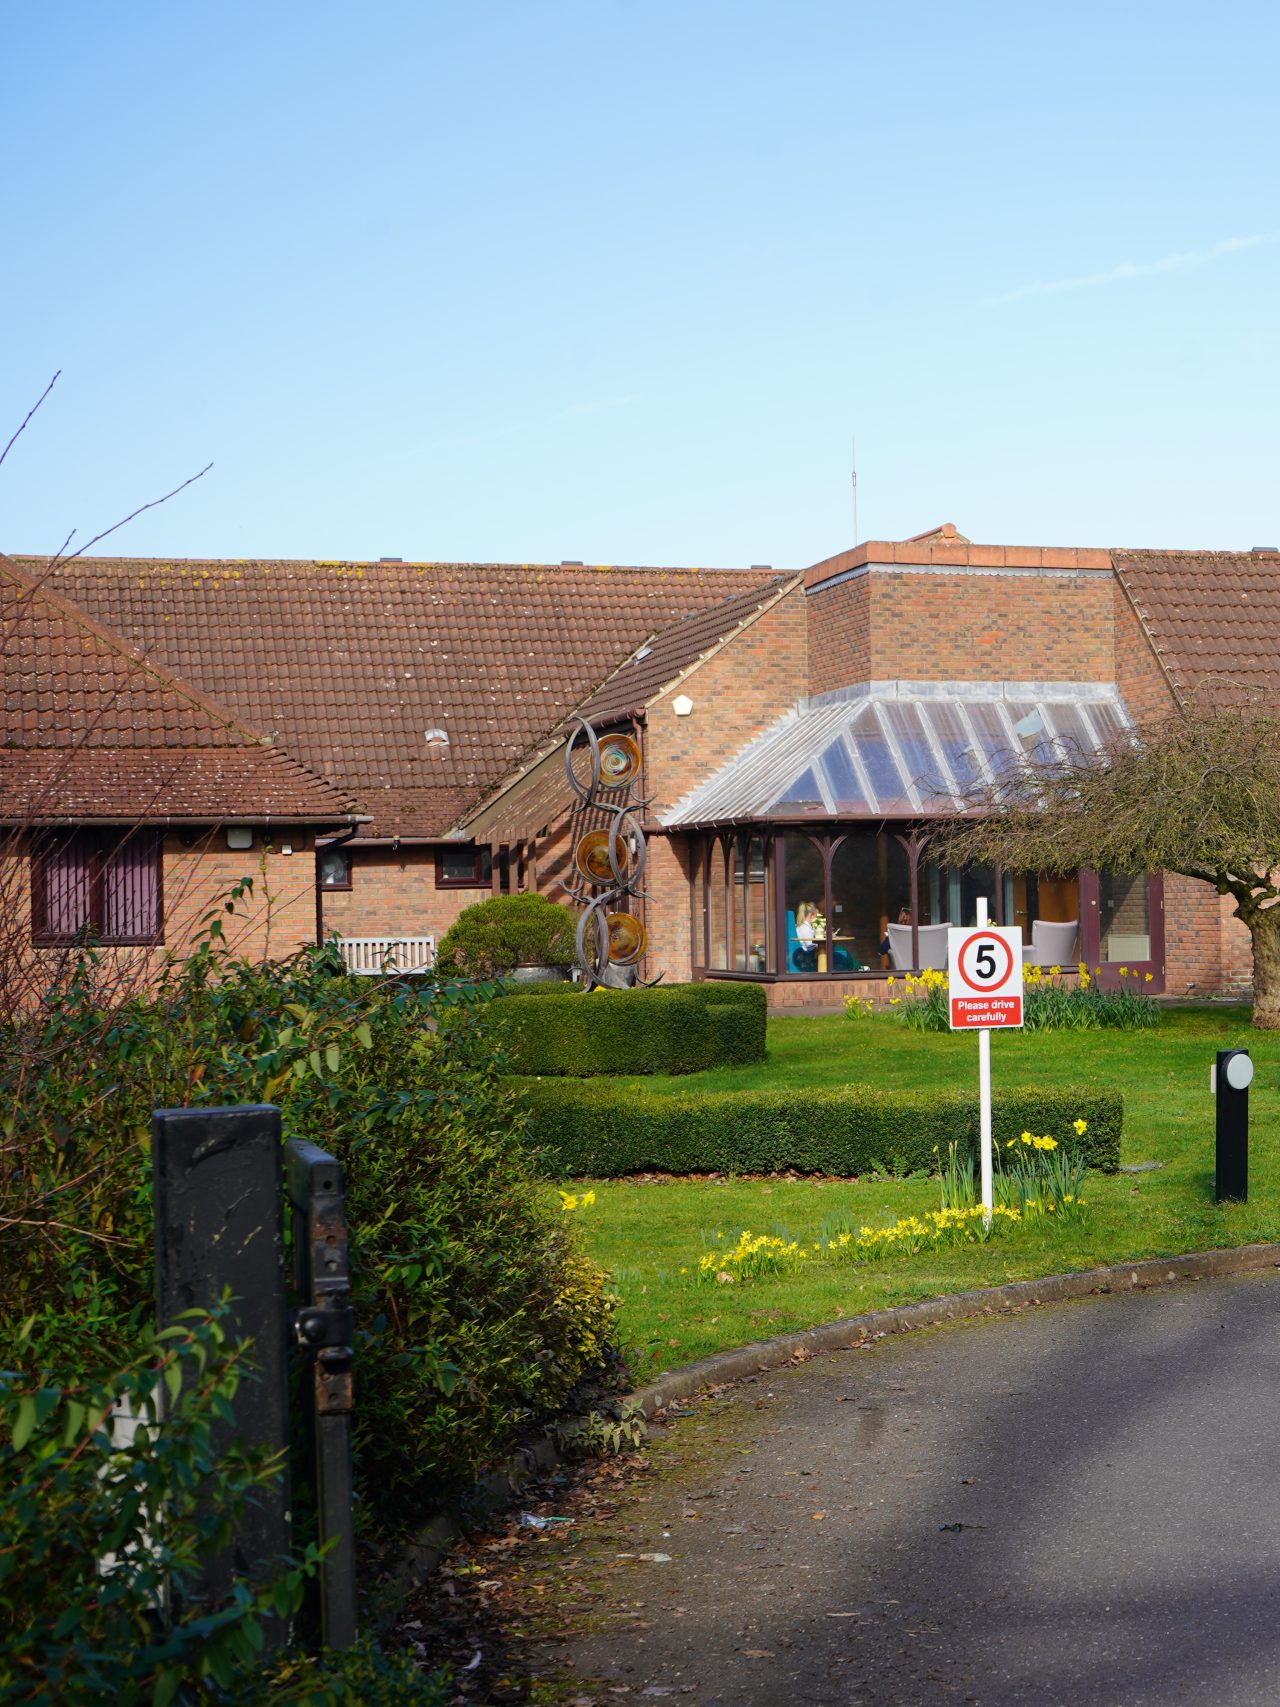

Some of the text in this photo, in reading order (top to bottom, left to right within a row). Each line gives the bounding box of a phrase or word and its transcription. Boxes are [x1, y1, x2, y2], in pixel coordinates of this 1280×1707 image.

[975, 945, 996, 979] 5
[958, 1000, 1015, 1010] Please drive
[966, 1012, 1007, 1023] carefully
